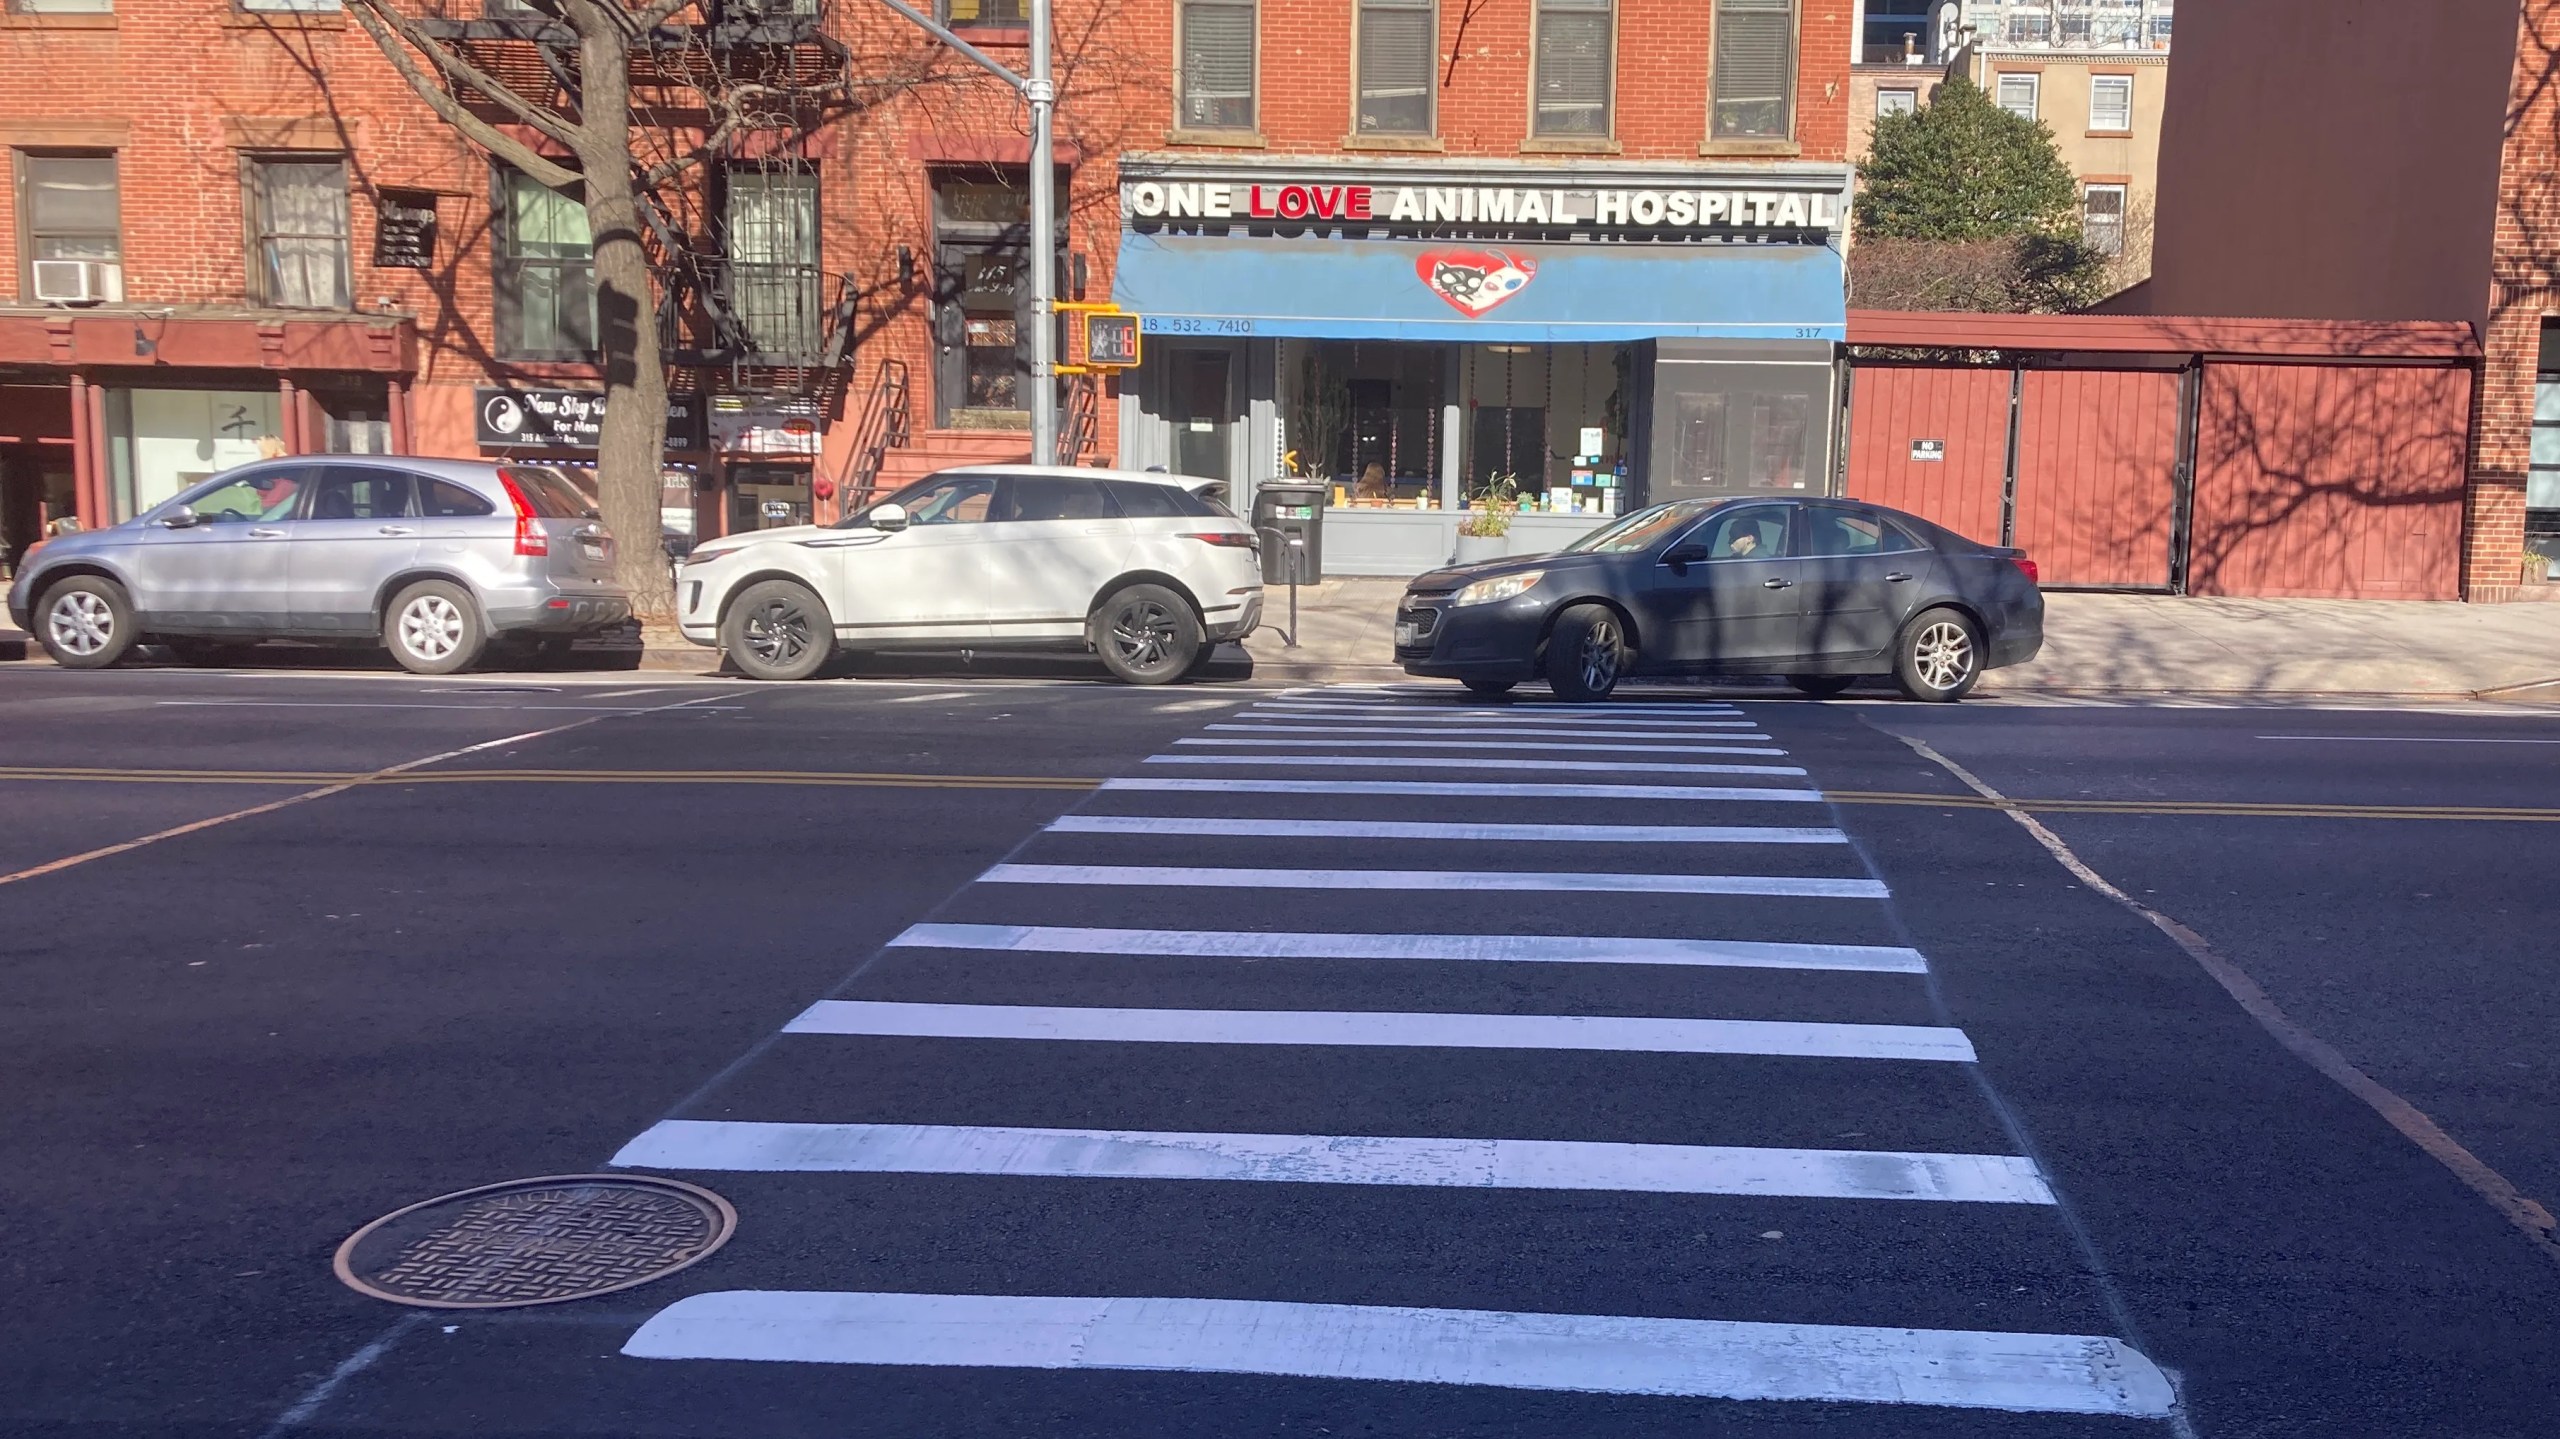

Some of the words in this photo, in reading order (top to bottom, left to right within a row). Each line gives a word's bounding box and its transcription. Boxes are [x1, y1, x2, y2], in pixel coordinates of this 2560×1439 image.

[1132, 183, 1232, 218] ONE
[1250, 184, 1373, 220] LOVE
[1389, 187, 1577, 225] ANIMAL
[1599, 190, 1836, 227] HOSPITAL
[1140, 318, 1158, 331] 18
[1173, 319, 1201, 331] 532
[1216, 320, 1251, 333] 7410
[1795, 327, 1822, 338] 317
[523, 393, 557, 413] New
[559, 395, 590, 420] Sky
[553, 420, 572, 432] For
[574, 421, 599, 433] Men
[1921, 441, 1934, 450] NO
[1912, 450, 1942, 459] PARKING
[765, 504, 788, 515] OPEN
